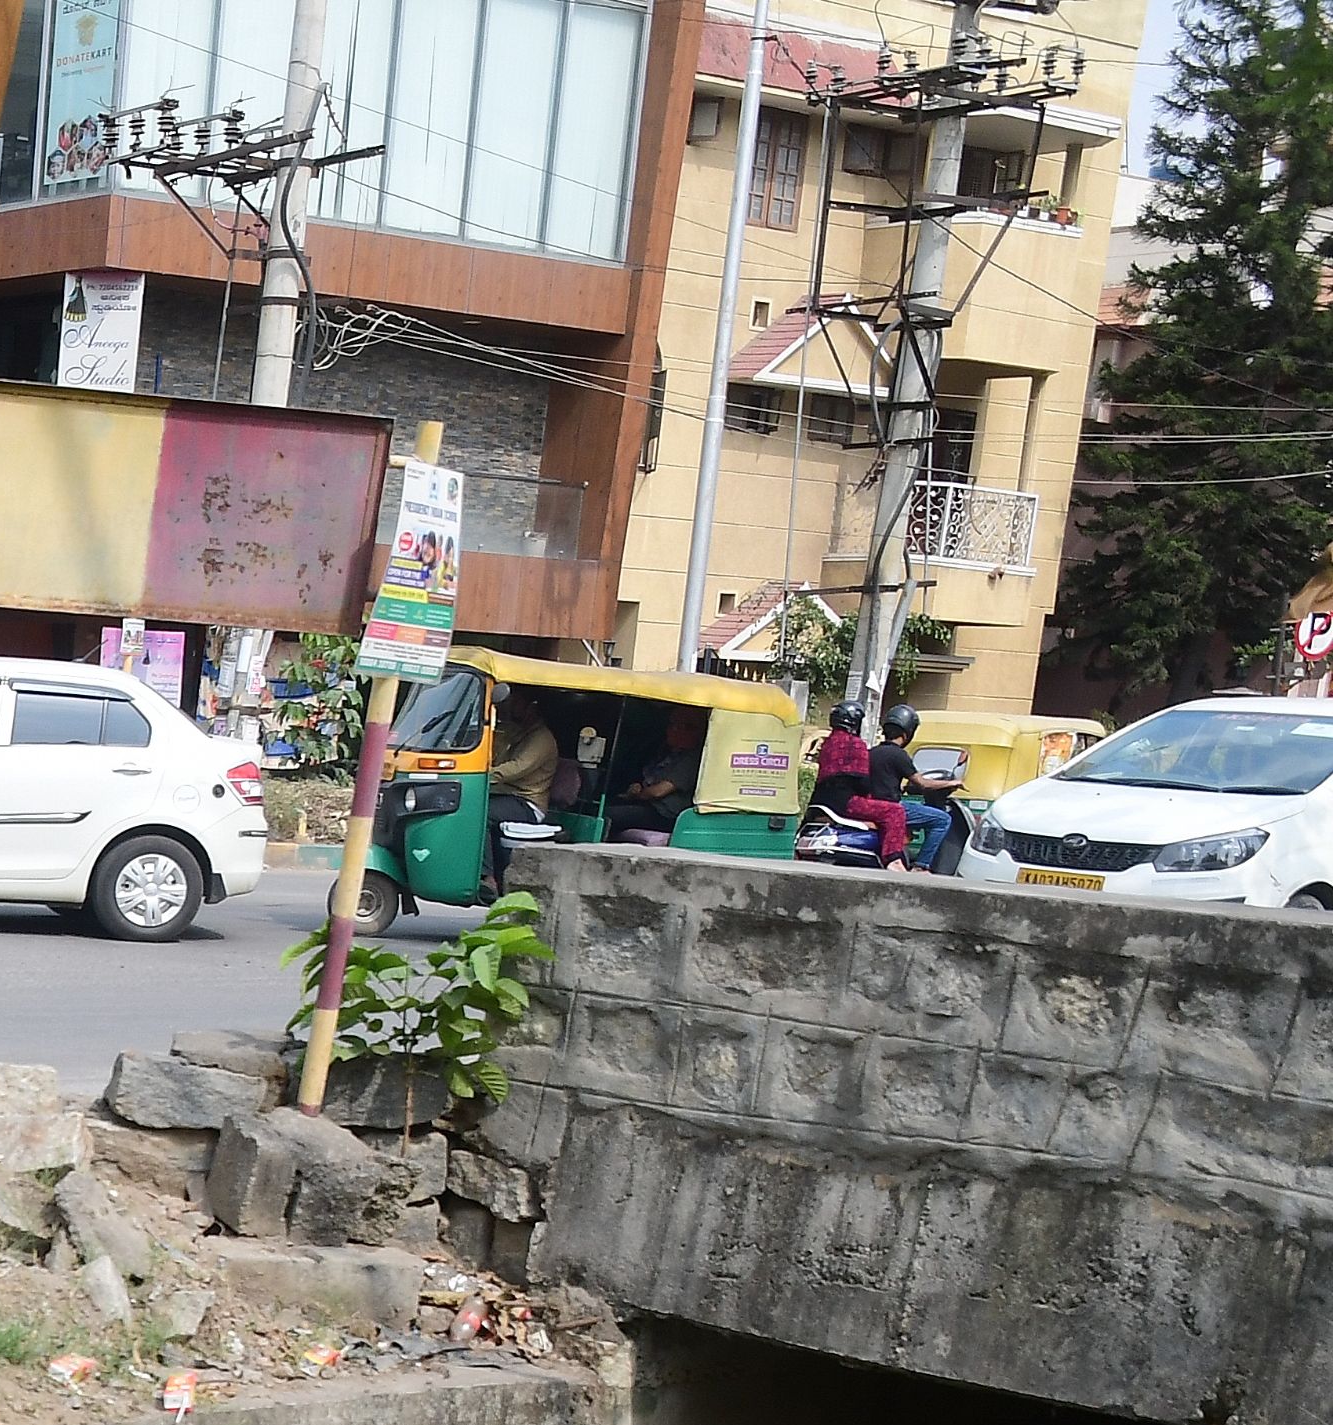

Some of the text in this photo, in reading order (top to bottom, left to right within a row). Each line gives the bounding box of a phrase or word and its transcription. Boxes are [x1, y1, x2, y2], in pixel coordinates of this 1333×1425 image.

[65, 354, 130, 385] Studio
[733, 756, 787, 767] DRESS CIRCLE
